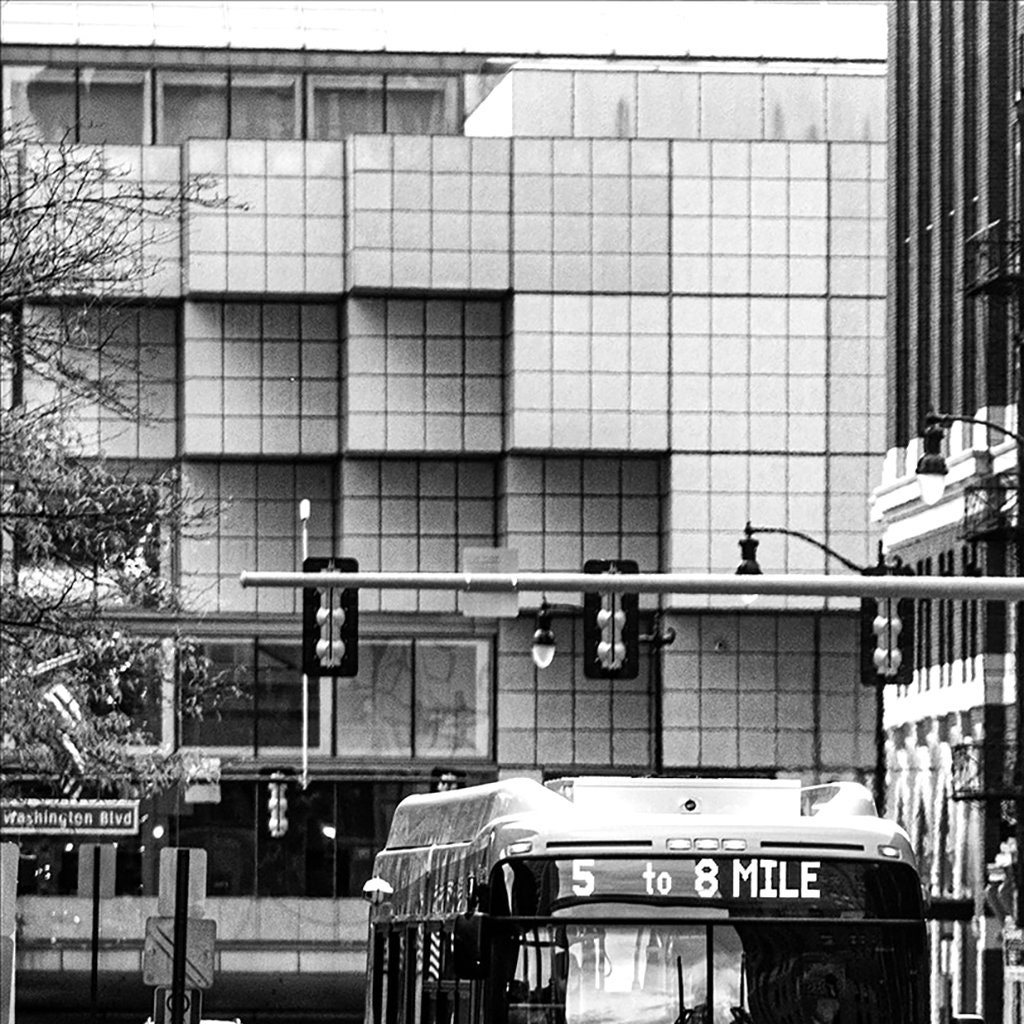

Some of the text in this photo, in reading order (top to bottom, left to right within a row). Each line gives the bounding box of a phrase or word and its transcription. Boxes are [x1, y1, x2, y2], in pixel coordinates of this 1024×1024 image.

[3, 808, 131, 828] Washington Blvd
[572, 858, 821, 898] 5 to 8 MILE
